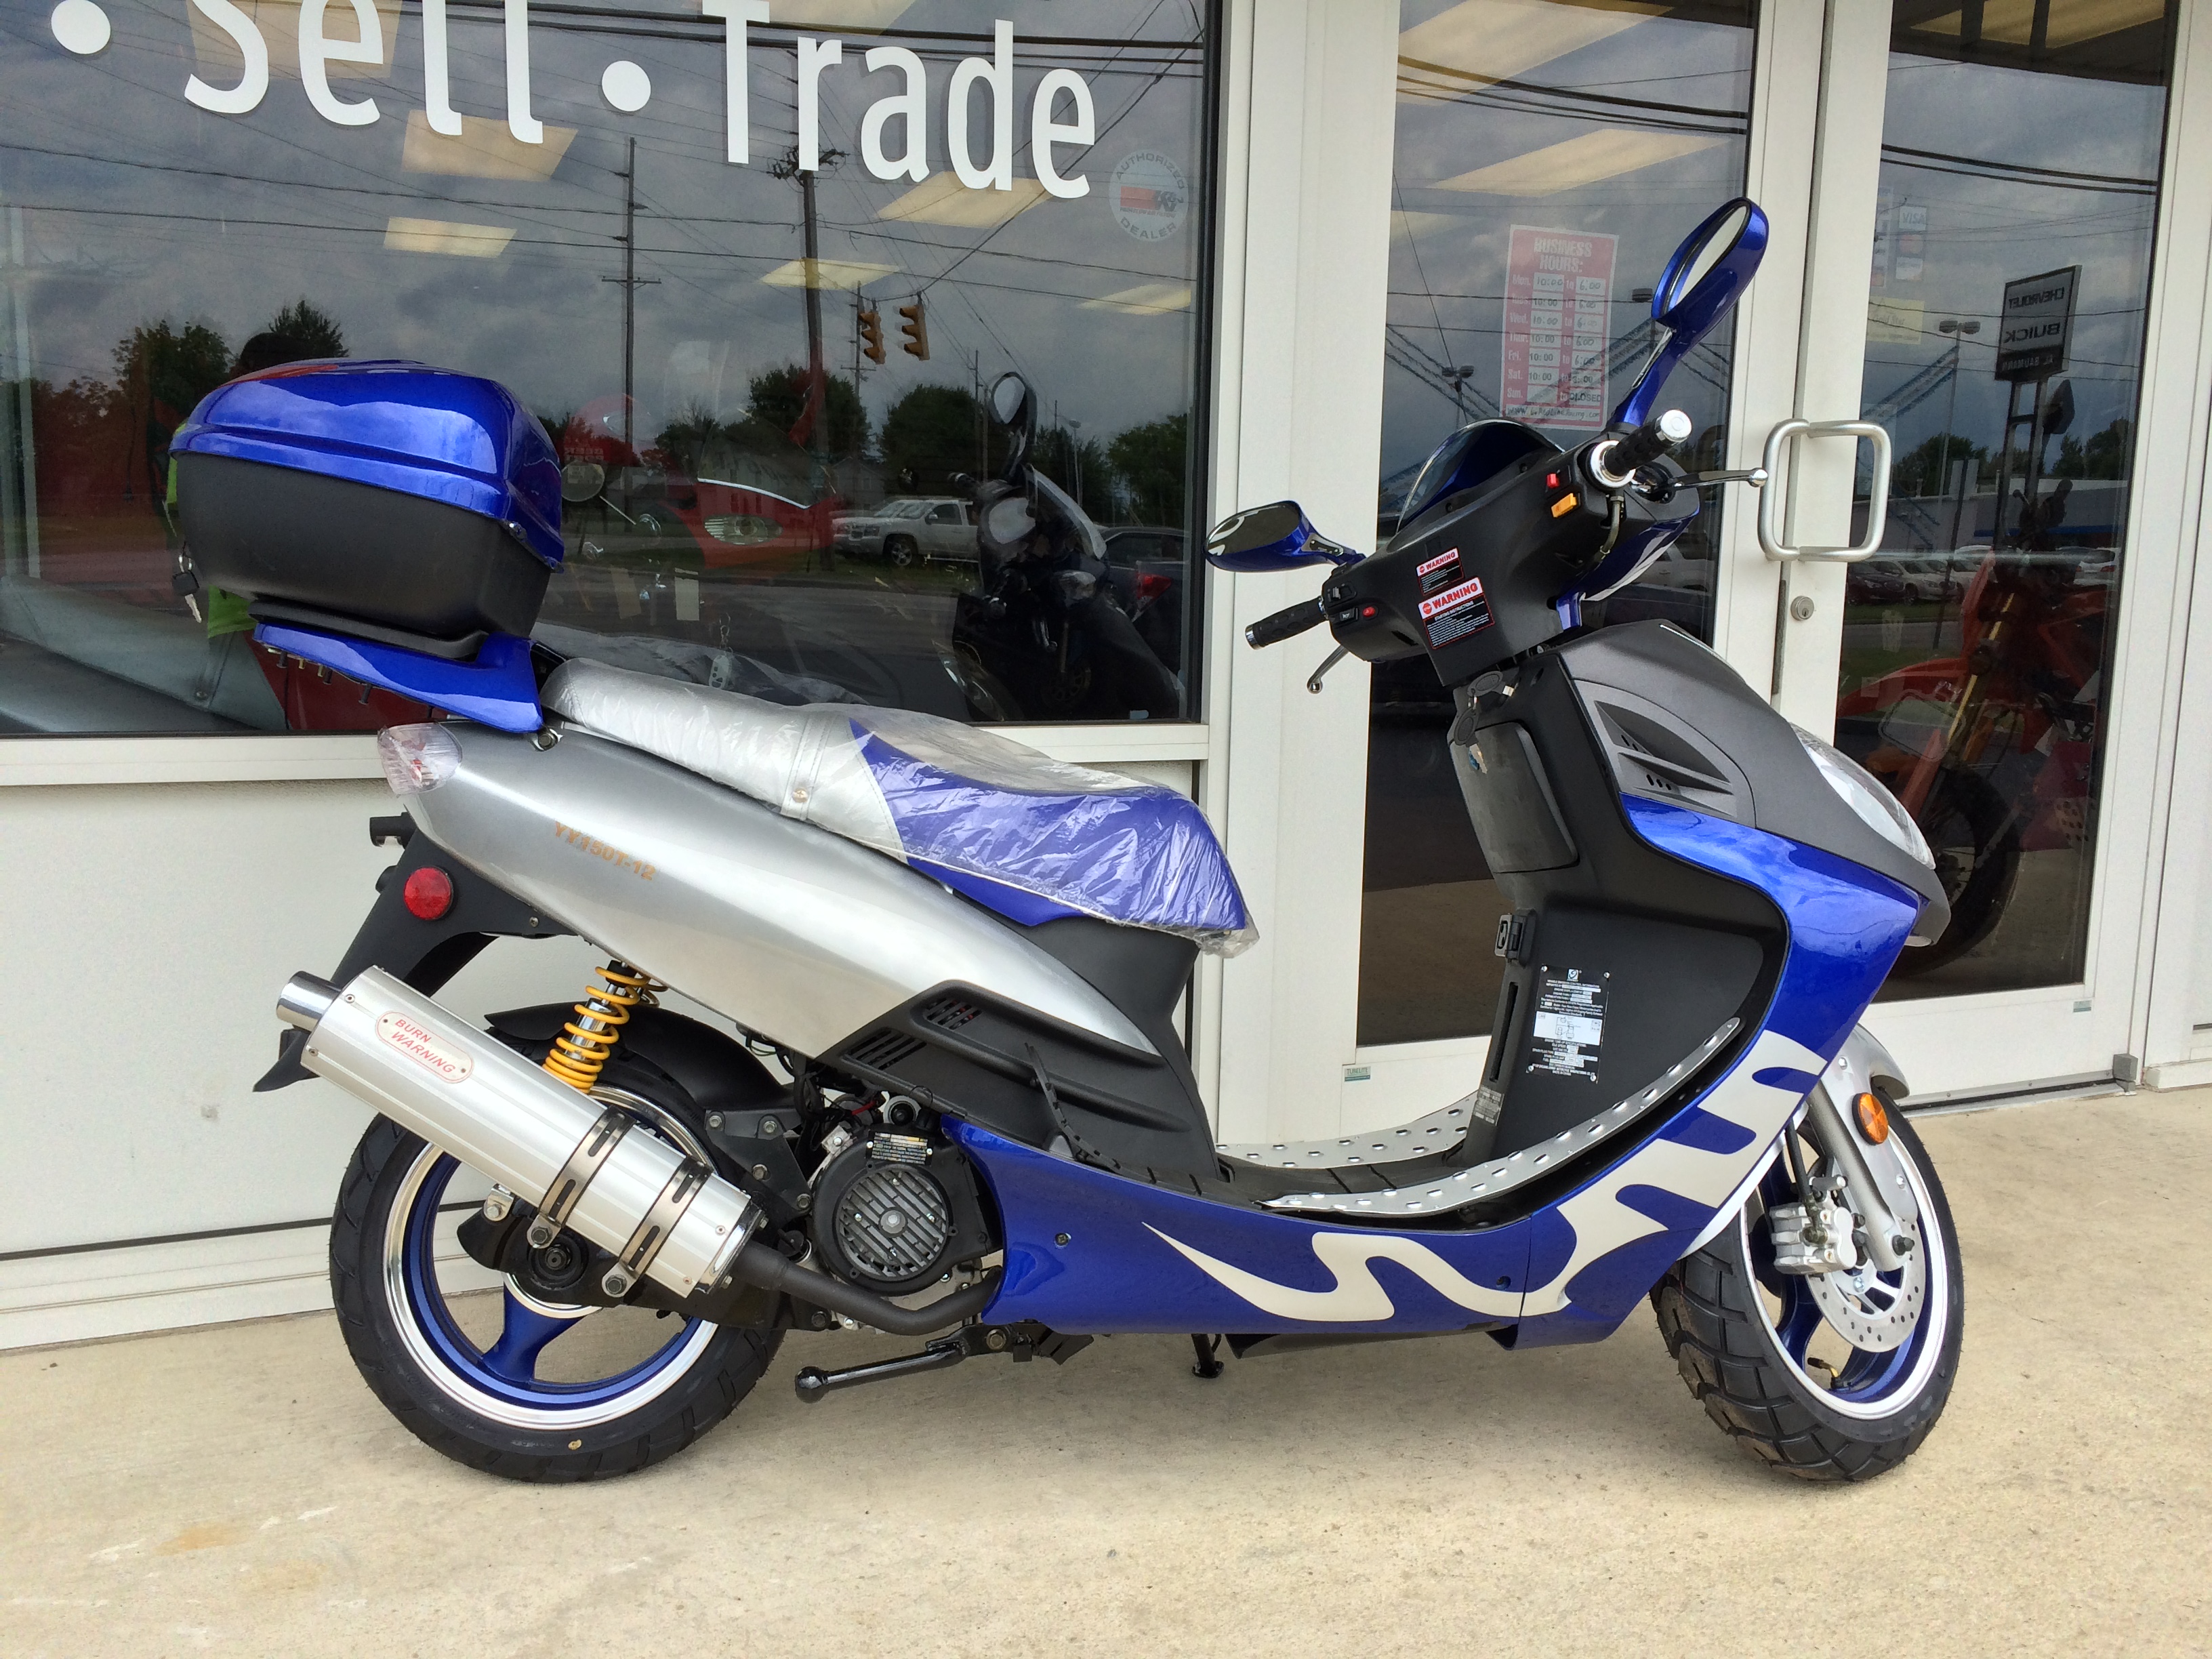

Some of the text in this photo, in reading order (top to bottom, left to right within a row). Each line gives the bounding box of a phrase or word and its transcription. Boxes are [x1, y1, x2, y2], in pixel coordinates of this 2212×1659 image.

[184, 0, 1094, 199] Sell Trade
[1116, 152, 1185, 190] AUTHORIZED
[1120, 217, 1176, 239] DEALER
[1534, 237, 1593, 258] BUSINESS
[1539, 255, 1583, 272] HOURS:
[1537, 276, 1563, 286] 10:00
[1566, 279, 1574, 290] to
[1534, 298, 1558, 307] 10:00
[1533, 315, 1559, 326] 10:00
[1564, 316, 1572, 327] to
[1531, 335, 1555, 344] 10:00
[1563, 335, 1572, 346] to
[1508, 350, 1521, 361] Fri.
[1530, 353, 1554, 361] 10:00
[1563, 354, 1570, 365] to
[1508, 369, 1523, 380] Sat.
[1529, 373, 1553, 381] 10:00
[1507, 387, 1601, 402] Sun. to CLOSED
[1426, 552, 1456, 570] WARNING
[1432, 582, 1478, 609] WARNING
[555, 821, 656, 880] YY150T-12
[394, 1019, 432, 1043] BURN
[391, 1031, 456, 1073] WARNING
